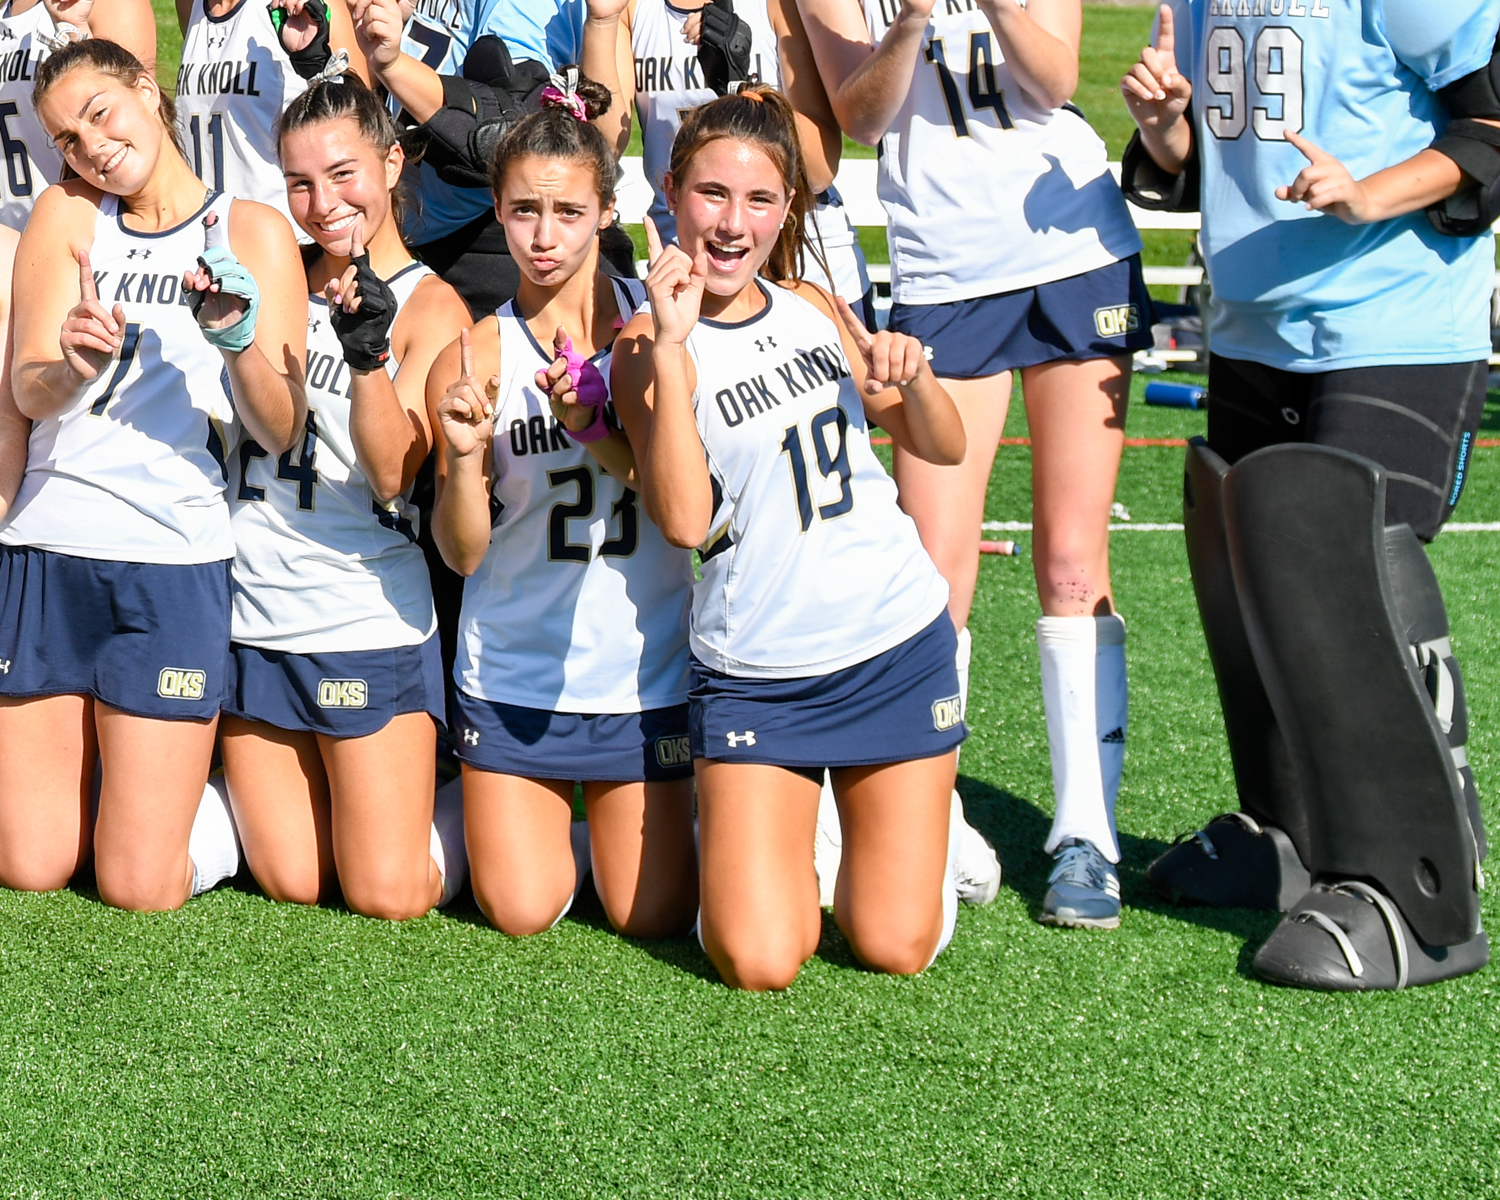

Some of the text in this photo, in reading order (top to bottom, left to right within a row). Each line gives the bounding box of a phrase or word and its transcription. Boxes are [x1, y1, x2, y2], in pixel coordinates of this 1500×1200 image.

[196, 60, 261, 98] KNOLL
[634, 55, 676, 93] OAK
[924, 30, 1018, 138] 14
[1207, 26, 1305, 141] 99
[190, 111, 226, 193] 11
[1095, 306, 1140, 336] OKS
[715, 374, 782, 428] OAK
[236, 407, 320, 513] 24
[510, 415, 571, 457] OAK
[1457, 430, 1472, 472] SHORTS
[779, 404, 854, 535] 19
[547, 464, 639, 564] 23
[159, 668, 205, 699] OKS
[319, 680, 366, 708] OKS
